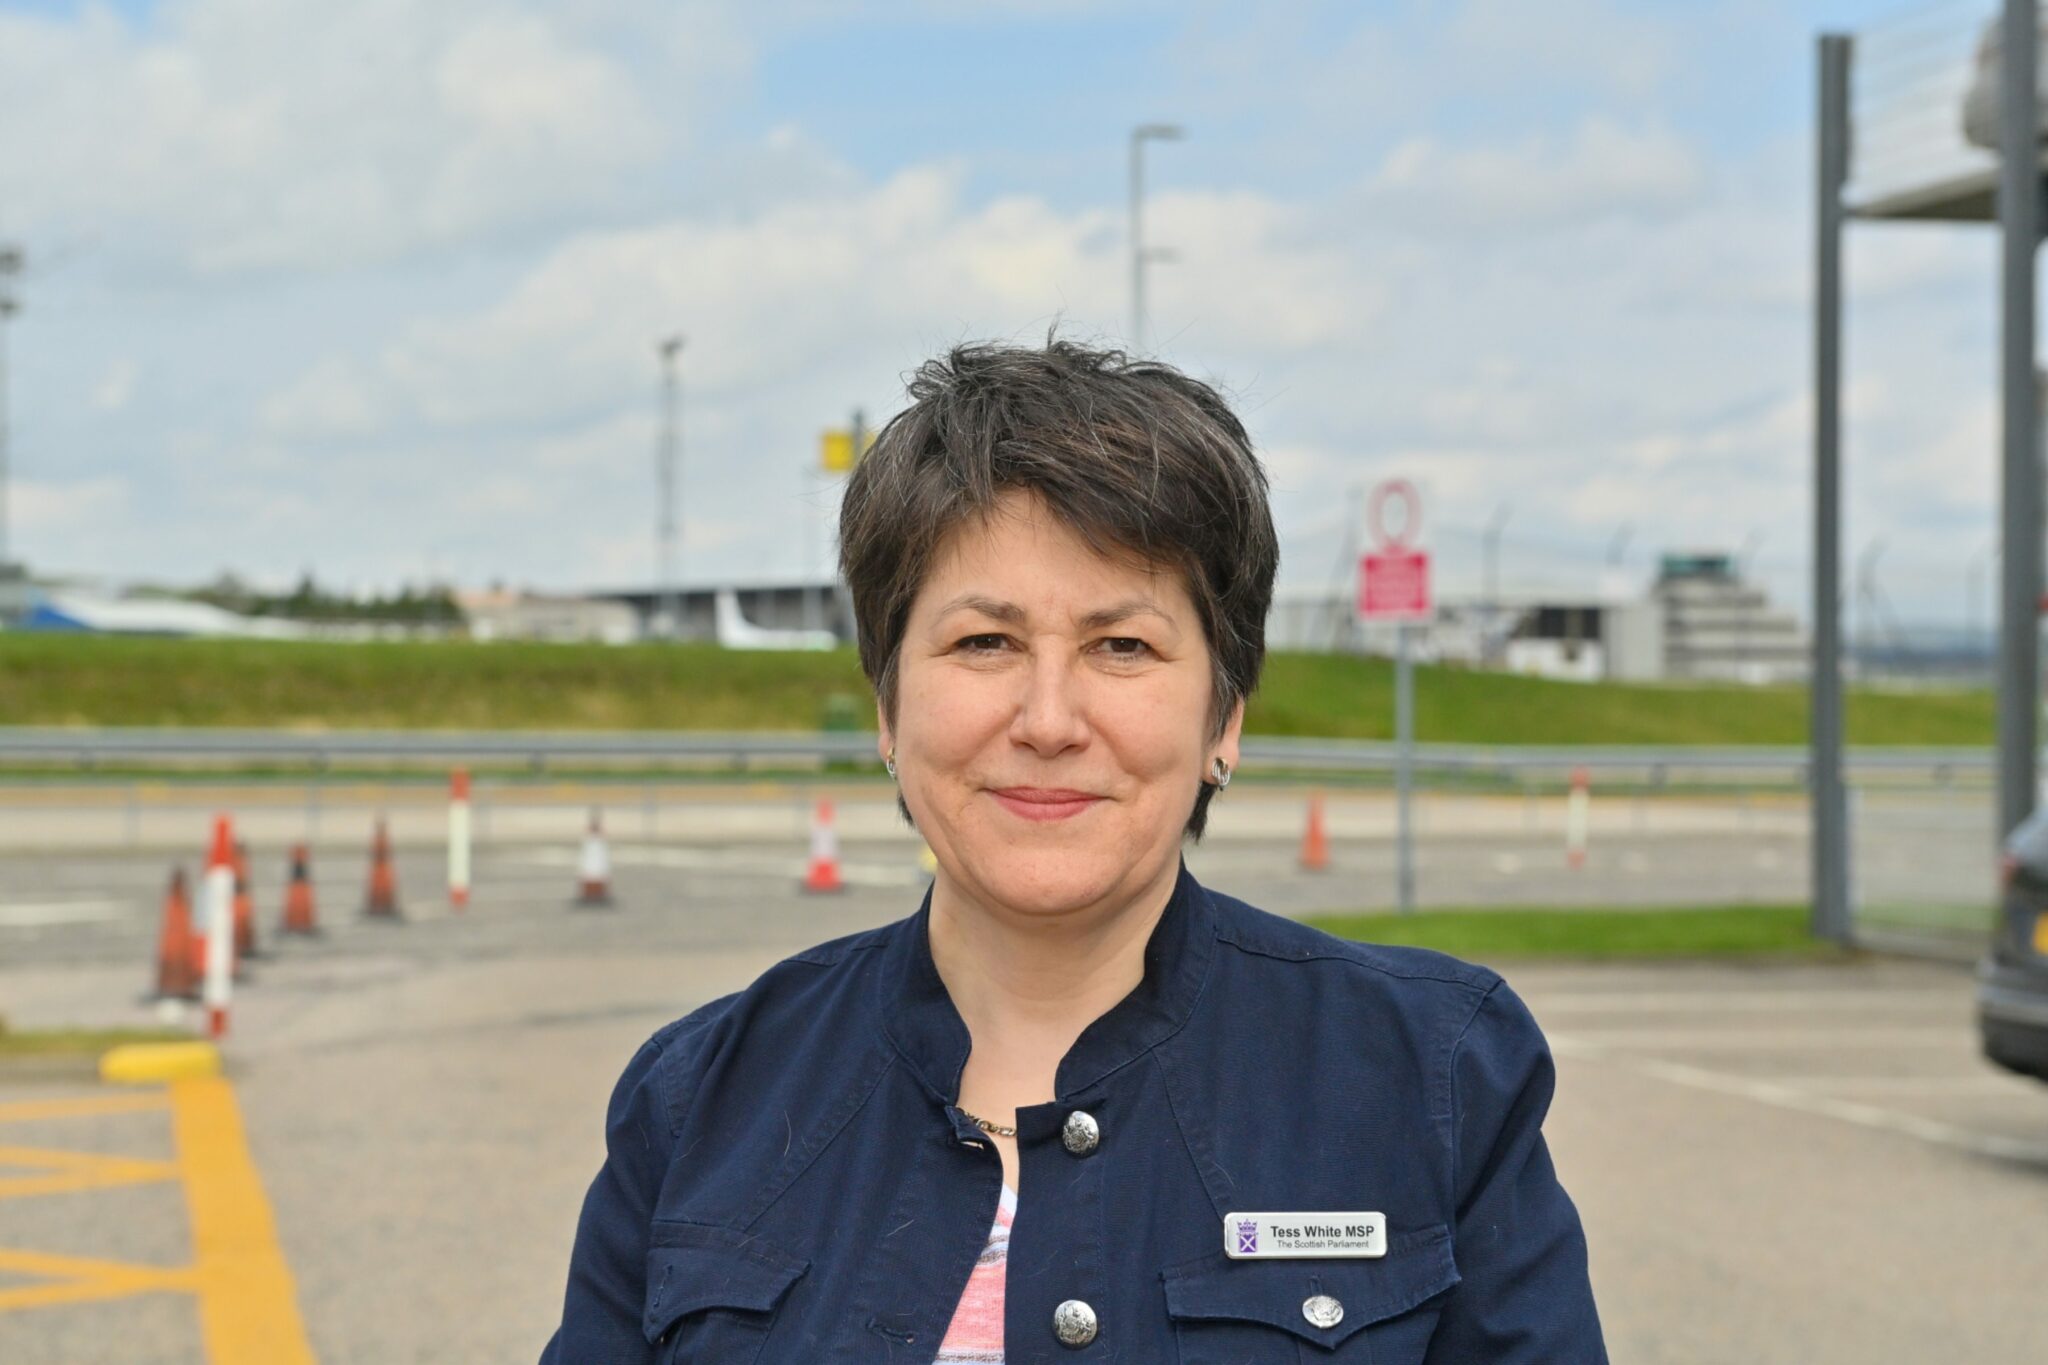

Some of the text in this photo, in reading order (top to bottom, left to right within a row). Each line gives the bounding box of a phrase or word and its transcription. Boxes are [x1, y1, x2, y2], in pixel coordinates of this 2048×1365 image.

[1270, 1225, 1375, 1238] Tess White MSP
[1278, 1240, 1369, 1249] The Scottish Parliament
